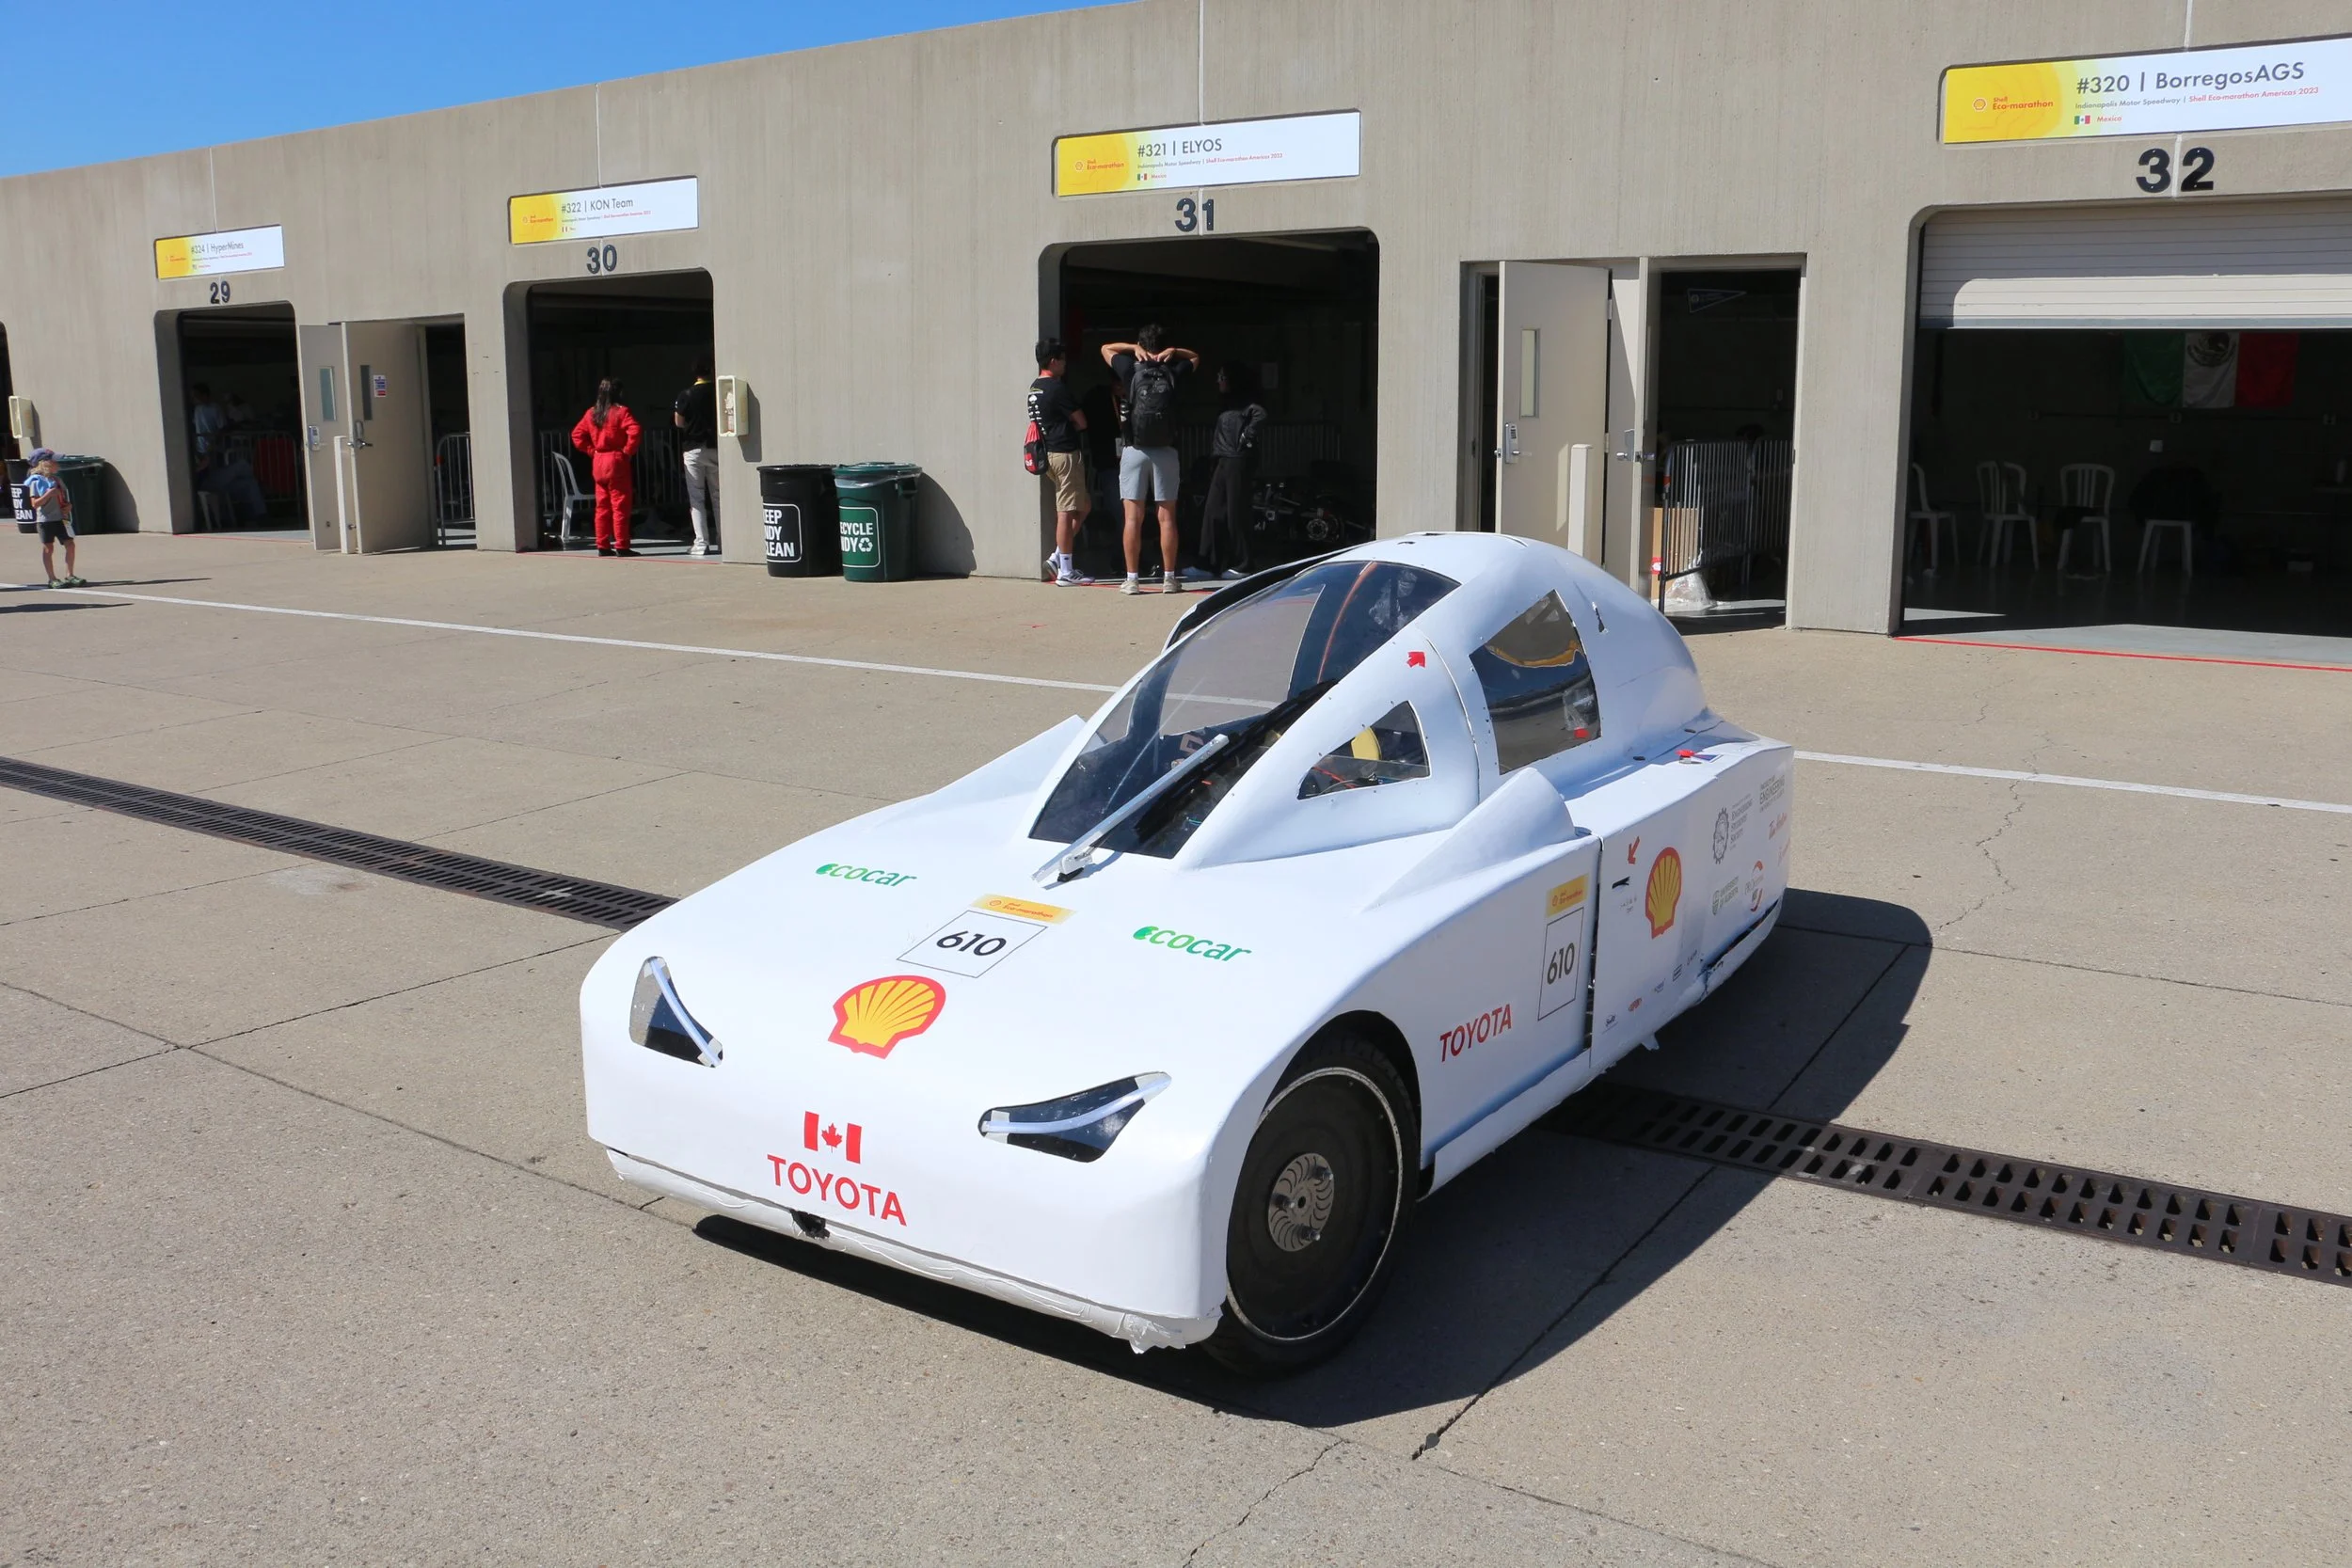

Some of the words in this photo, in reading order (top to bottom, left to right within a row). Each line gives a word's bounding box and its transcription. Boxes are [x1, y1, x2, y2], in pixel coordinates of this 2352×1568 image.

[2076, 74, 2130, 95] #320
[2155, 61, 2305, 90] BorregosAGS
[1992, 101, 2054, 110] Eco-marathon
[2074, 101, 2118, 110] Indianapolis
[2142, 97, 2181, 106] Speedway
[2208, 91, 2260, 102] Eco-marathon
[2261, 88, 2296, 98] Americas
[2298, 87, 2319, 95] 2023
[1136, 143, 1167, 158] #321
[1182, 138, 1222, 154] ELYOS
[2136, 147, 2216, 194] 32
[561, 201, 581, 214] #322
[590, 199, 611, 211] KON
[612, 198, 634, 209] Team
[1174, 198, 1215, 232] 31
[211, 241, 245, 255] HyperMines
[586, 244, 618, 275] 30
[210, 280, 230, 305] 29
[15, 509, 34, 520] EAN
[763, 509, 783, 525] EEP
[839, 521, 874, 536] ECYCLE
[766, 541, 795, 557] LEAN
[936, 929, 1008, 957] 610
[1547, 942, 1575, 985] 610
[1439, 1003, 1512, 1063] TOYOTA
[767, 1153, 908, 1227] TOYOTA
